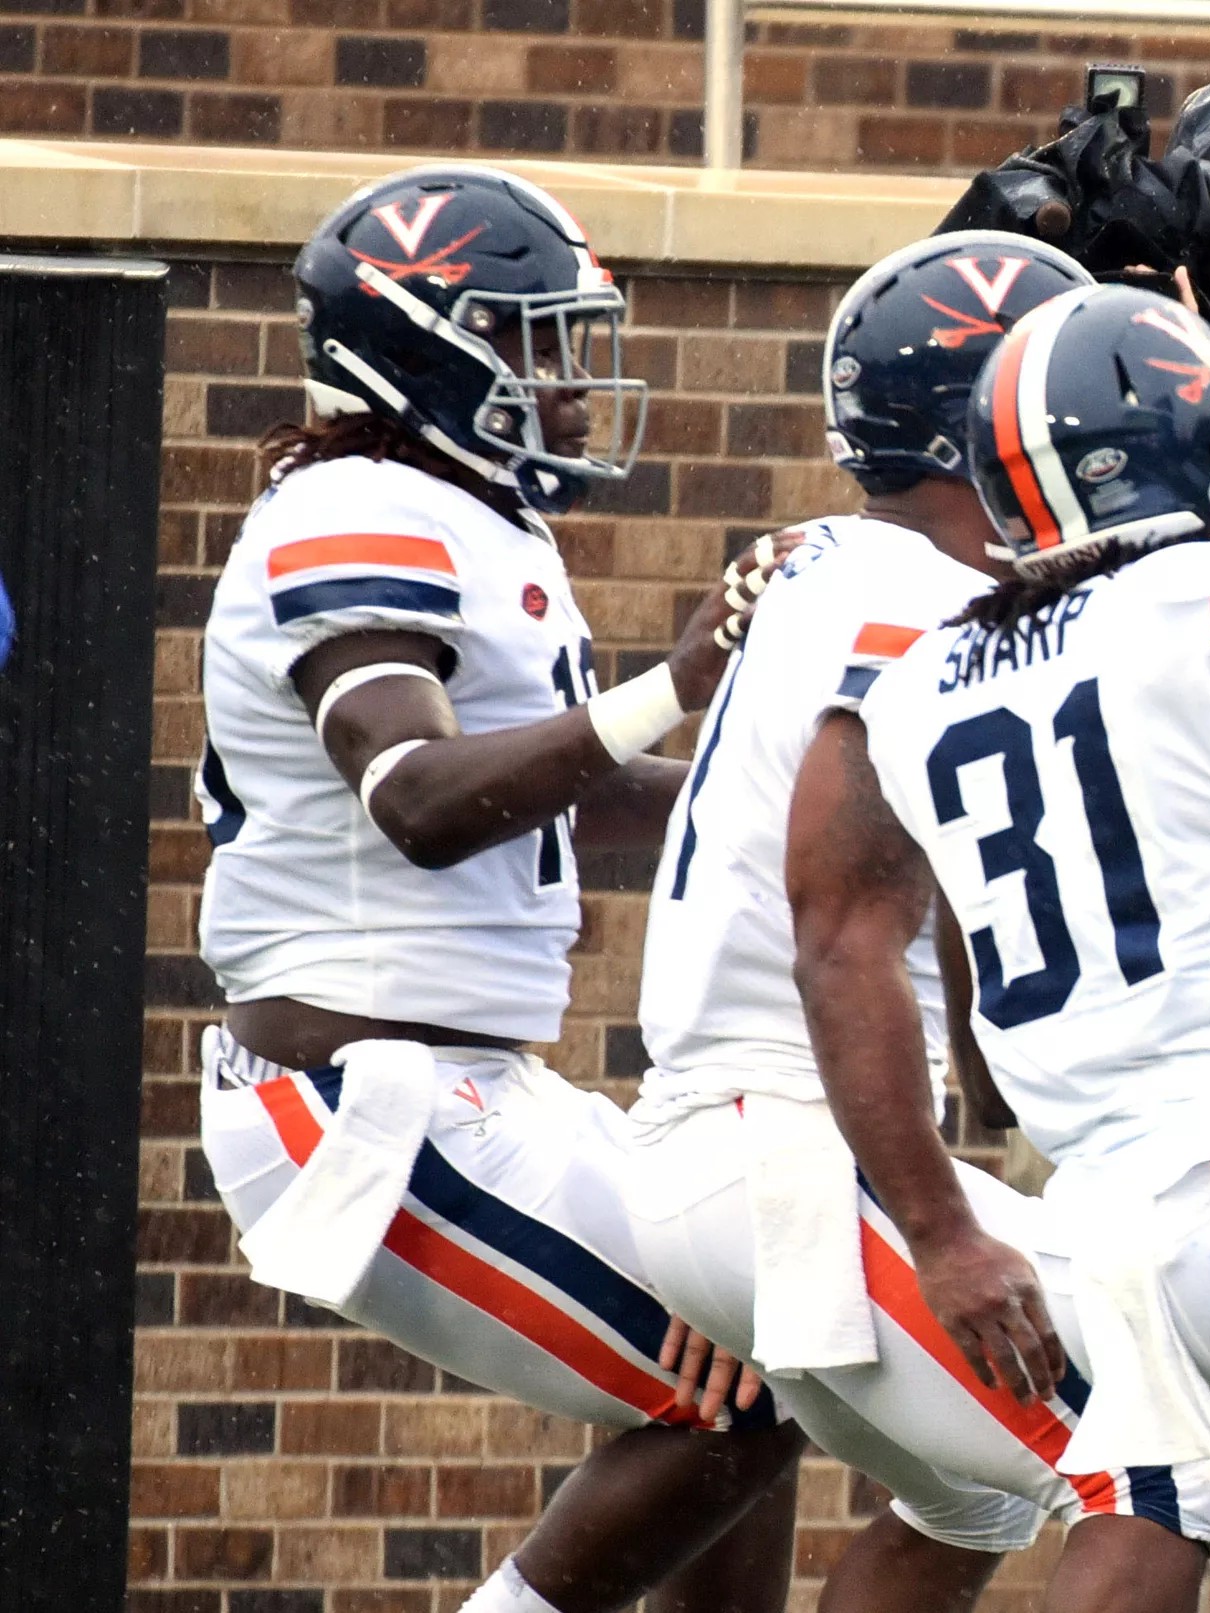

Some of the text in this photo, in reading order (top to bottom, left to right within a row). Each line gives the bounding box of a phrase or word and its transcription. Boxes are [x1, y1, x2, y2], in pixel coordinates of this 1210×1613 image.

[370, 191, 456, 259] V
[945, 256, 1031, 317] V
[926, 676, 1166, 1030] 31
